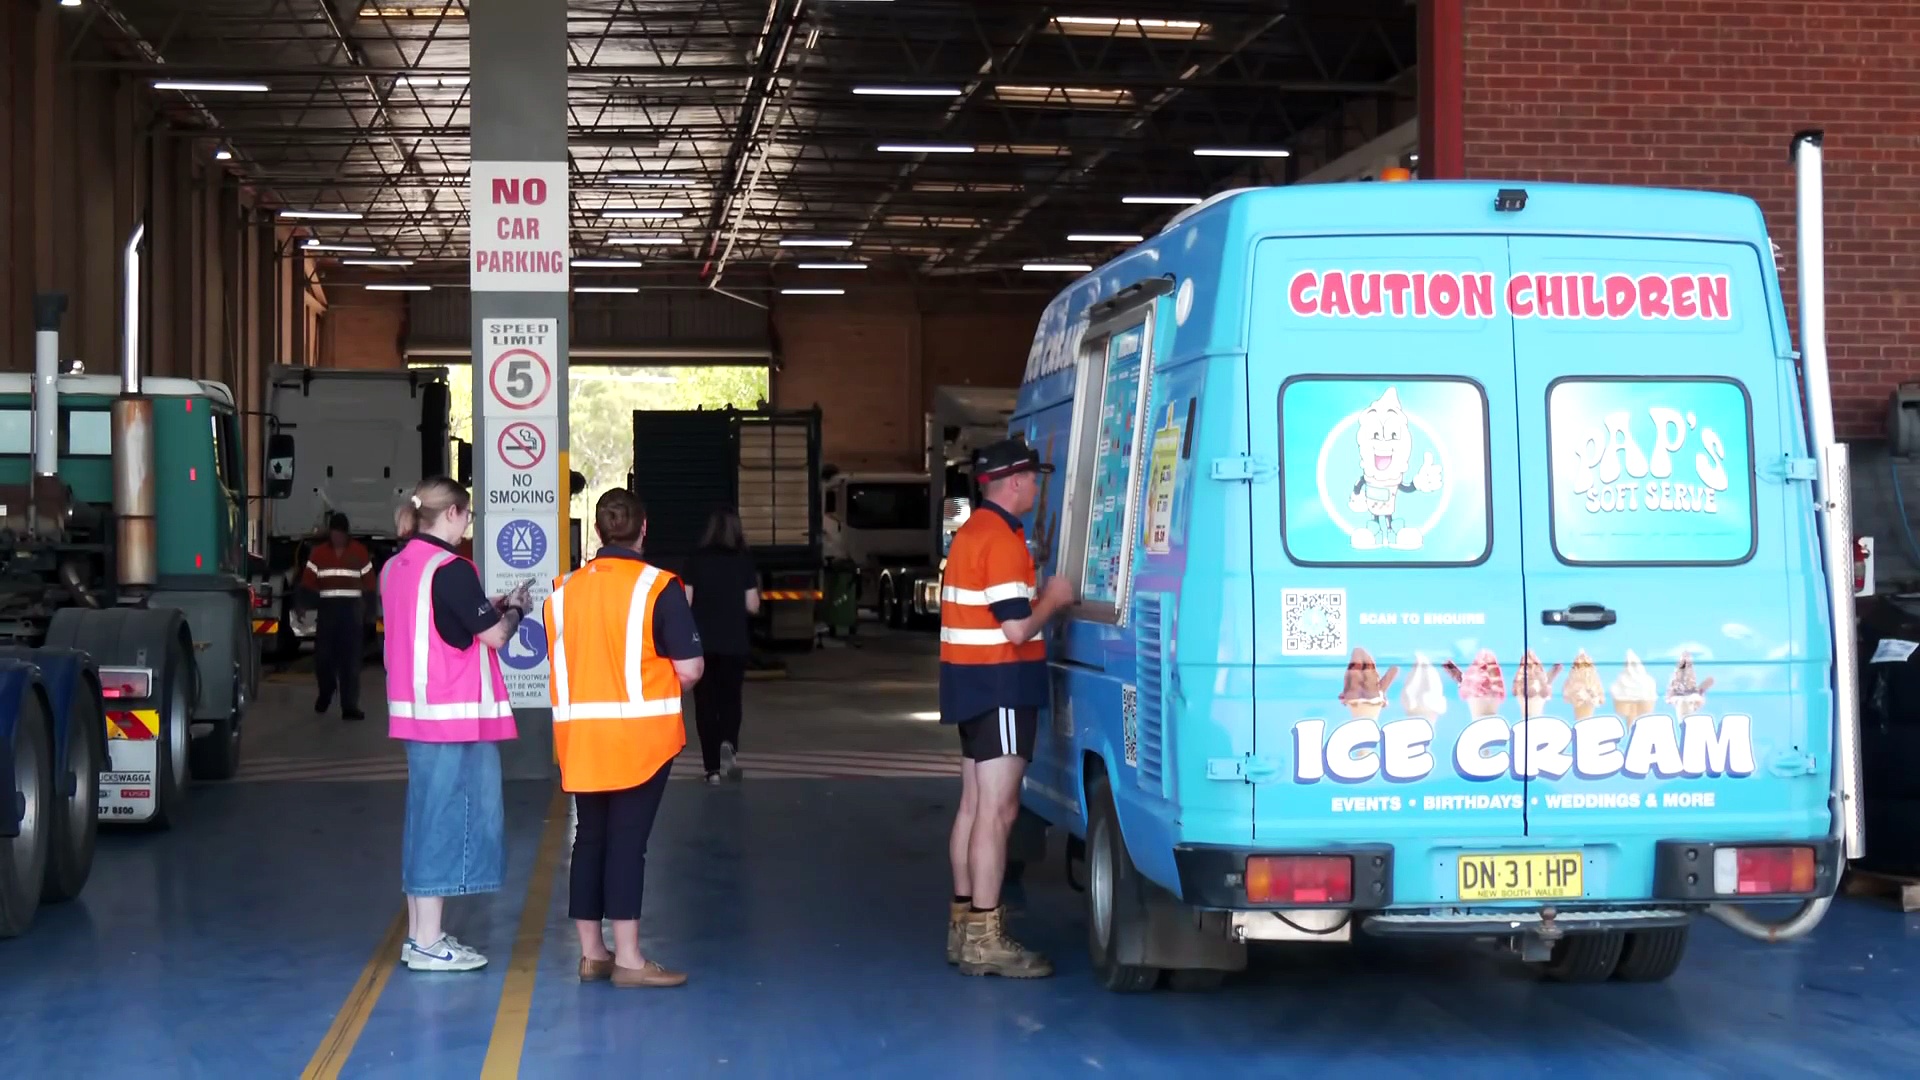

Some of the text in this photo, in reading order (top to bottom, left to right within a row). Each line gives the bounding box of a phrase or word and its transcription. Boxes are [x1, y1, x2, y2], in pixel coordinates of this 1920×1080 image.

[492, 178, 547, 205] NO
[497, 216, 540, 240] CAR
[476, 250, 563, 273] PARKING
[1288, 271, 1731, 320] CAUTION CHILDREN
[490, 324, 549, 333] SPEED
[493, 335, 546, 345] LIMIT
[506, 361, 533, 399] 5
[512, 473, 532, 487] NO
[490, 490, 554, 504] SMOKING
[1585, 482, 1717, 514] SOFT SERVE
[1359, 612, 1397, 625] SCAN
[1402, 612, 1420, 625] TO
[1291, 714, 1756, 785] ICE CREAM
[1331, 792, 1715, 812] EVENTS BIRTHDAYS WEDDINGS & MORE
[1478, 888, 1564, 897] NEW SOUTH WALES
